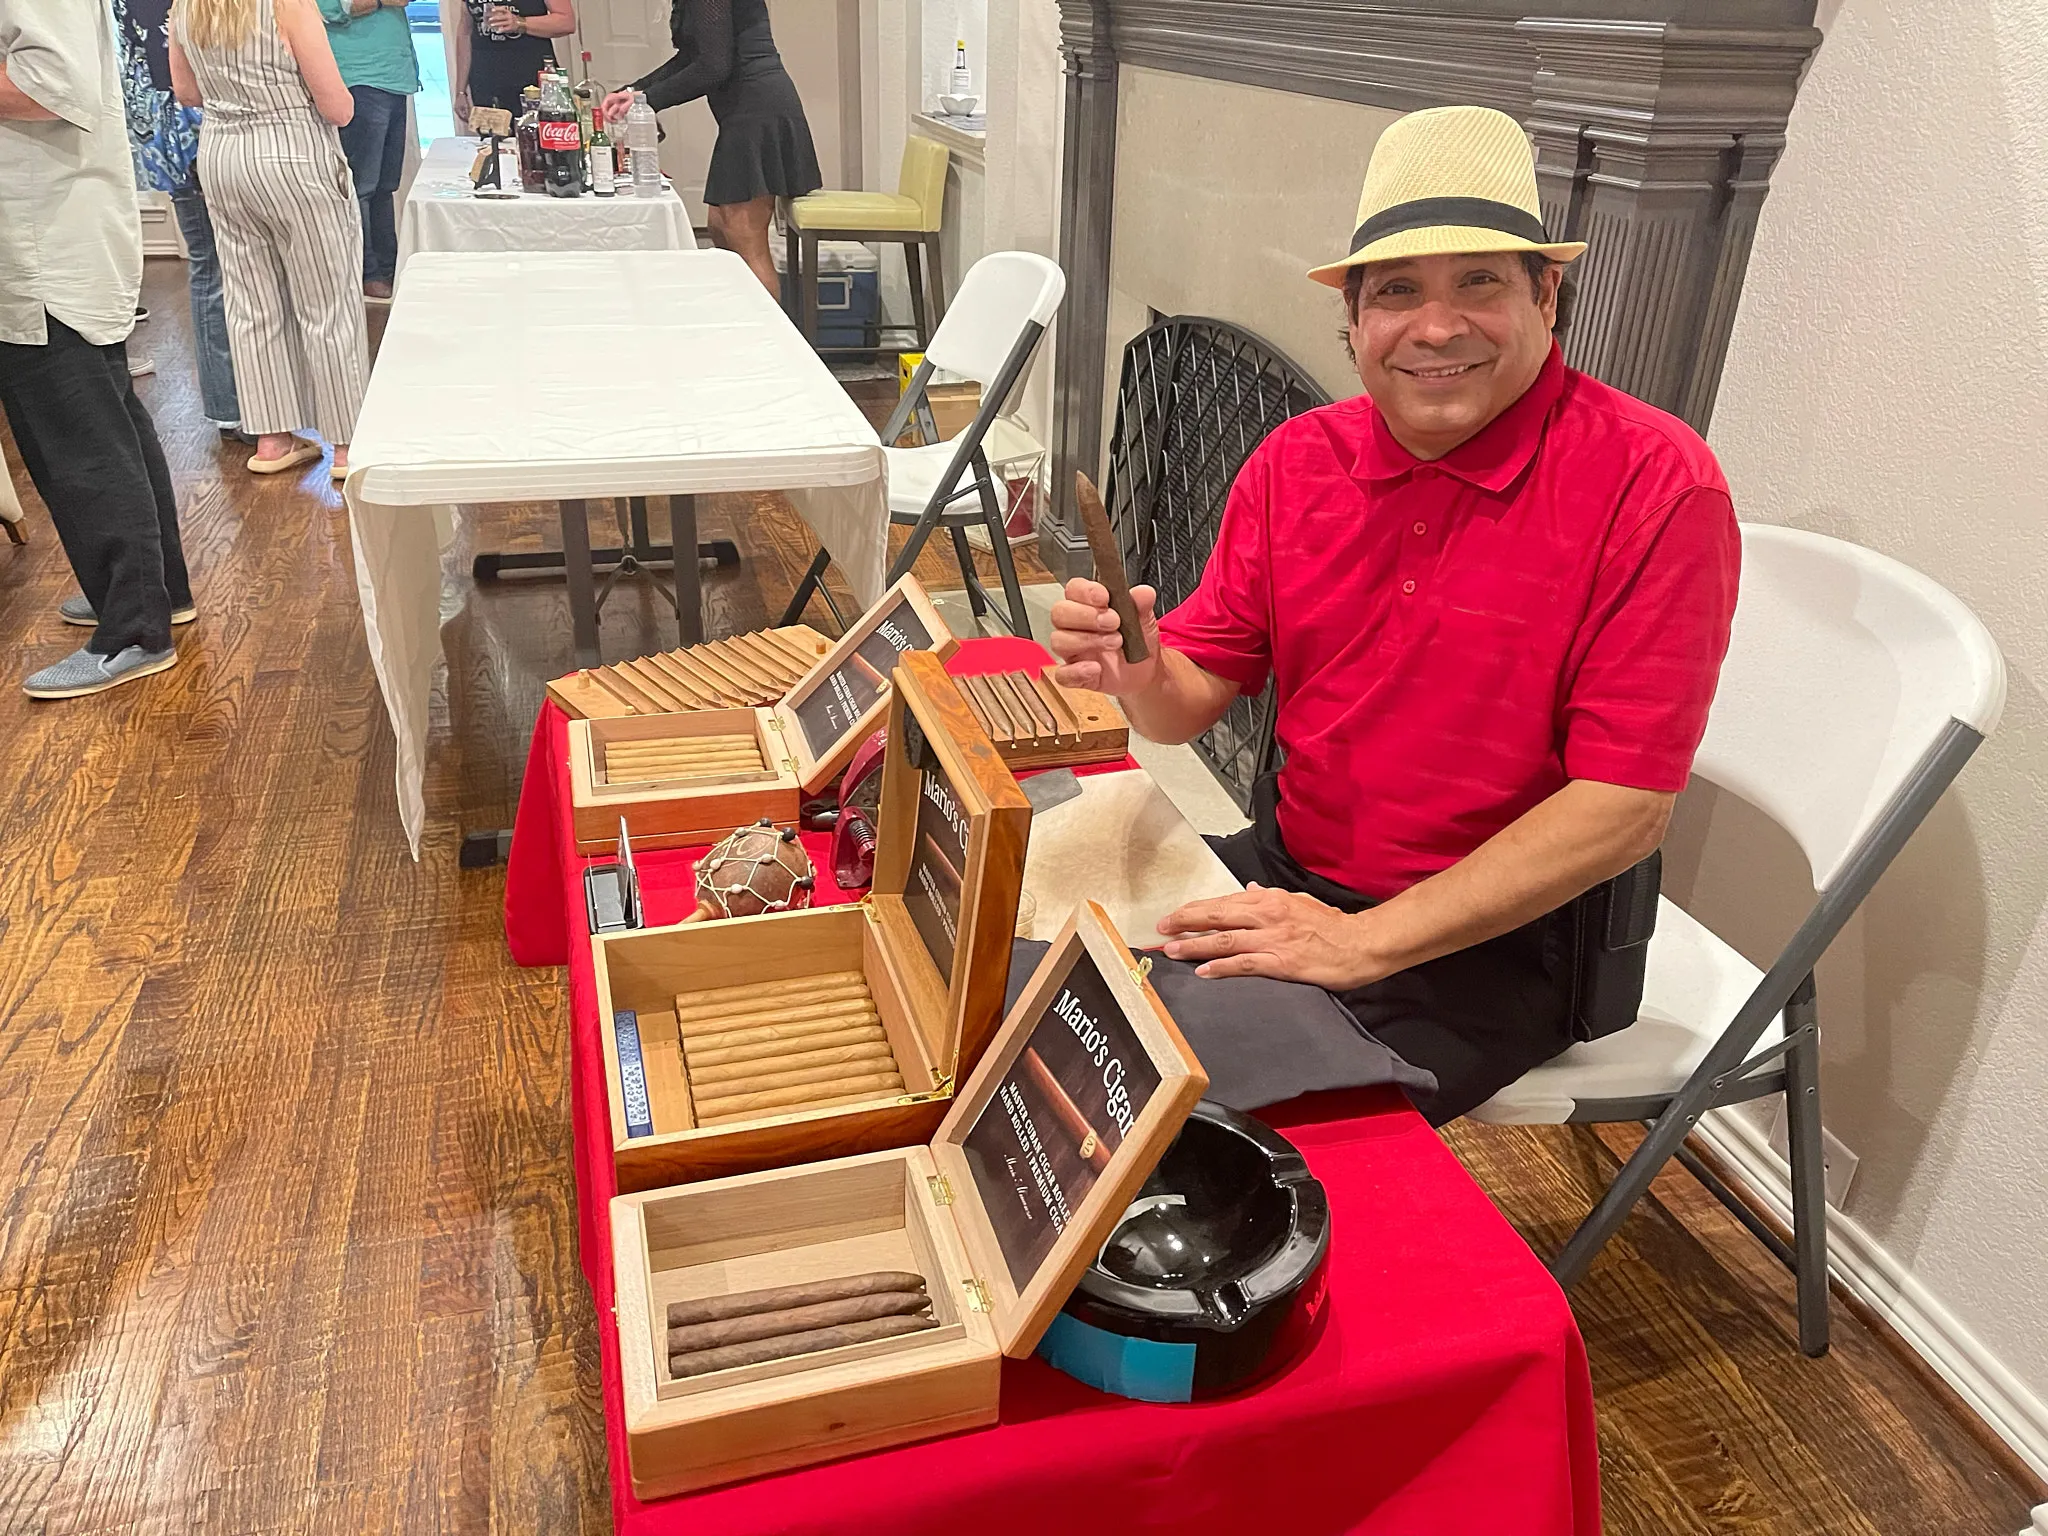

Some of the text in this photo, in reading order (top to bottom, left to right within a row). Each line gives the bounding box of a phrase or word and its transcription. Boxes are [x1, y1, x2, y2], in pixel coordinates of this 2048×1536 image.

[875, 619, 908, 652] Mario's
[924, 770, 959, 833] Mario's
[1052, 988, 1109, 1067] Mario's
[1000, 1085, 1015, 1115] HAND
[1010, 1112, 1030, 1155] ROLLED
[1028, 1156, 1053, 1208] PREMIUM
[1009, 1081, 1029, 1121] MASTER
[1024, 1118, 1043, 1154] CUBAN
[1038, 1152, 1056, 1186] CIGAR
